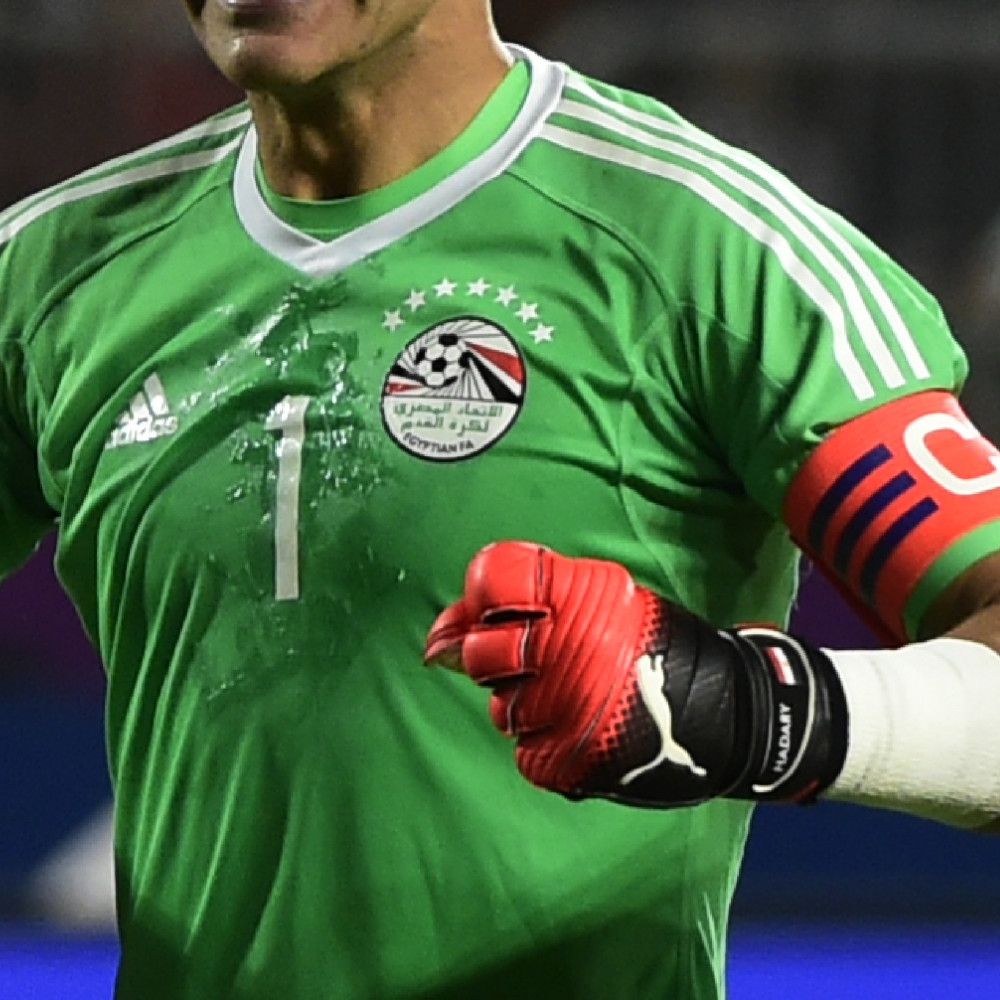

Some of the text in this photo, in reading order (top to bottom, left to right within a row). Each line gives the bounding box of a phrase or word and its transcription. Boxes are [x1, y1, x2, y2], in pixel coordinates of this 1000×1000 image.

[403, 432, 457, 452] EGYPTIAN
[903, 412, 1000, 495] C
[265, 395, 311, 600] 1
[773, 702, 792, 773] HADARY
